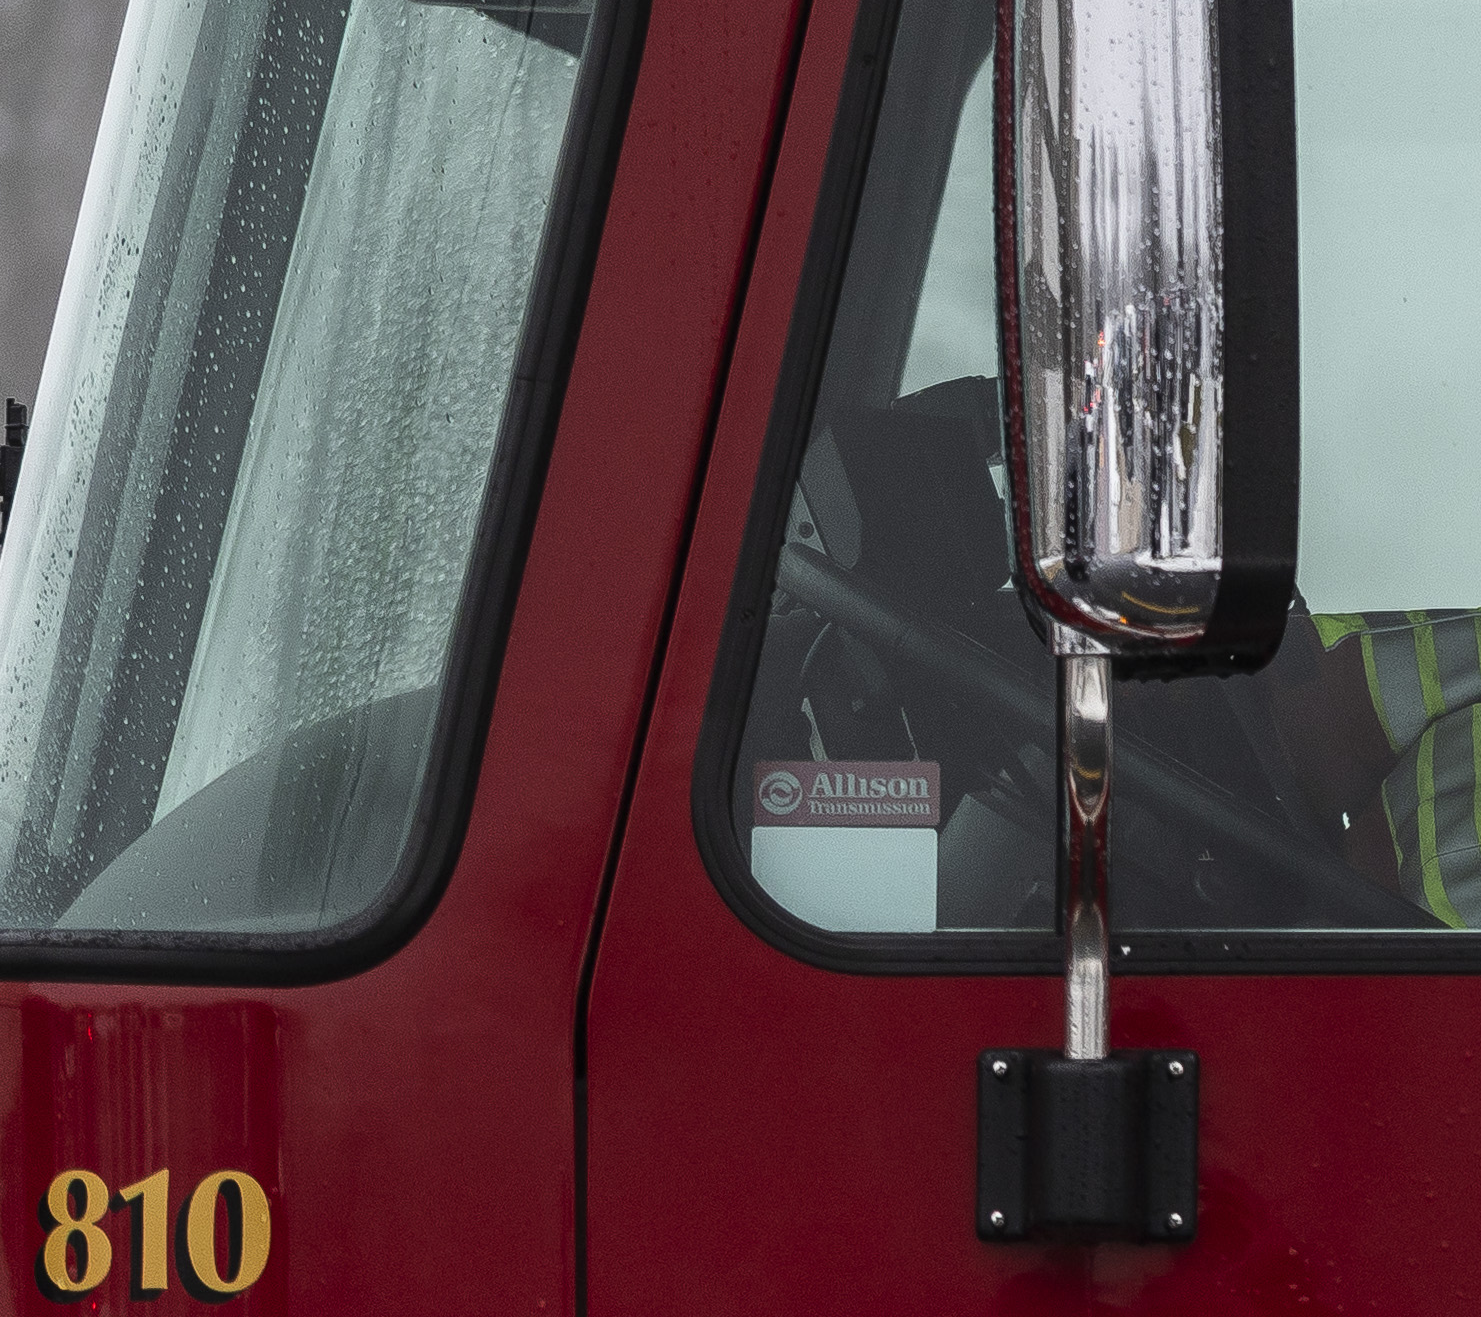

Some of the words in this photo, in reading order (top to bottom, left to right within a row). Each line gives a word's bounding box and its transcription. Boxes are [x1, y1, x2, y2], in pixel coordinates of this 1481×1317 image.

[808, 771, 931, 799] Allison
[809, 799, 931, 815] Transmission
[36, 1167, 271, 1303] 810
